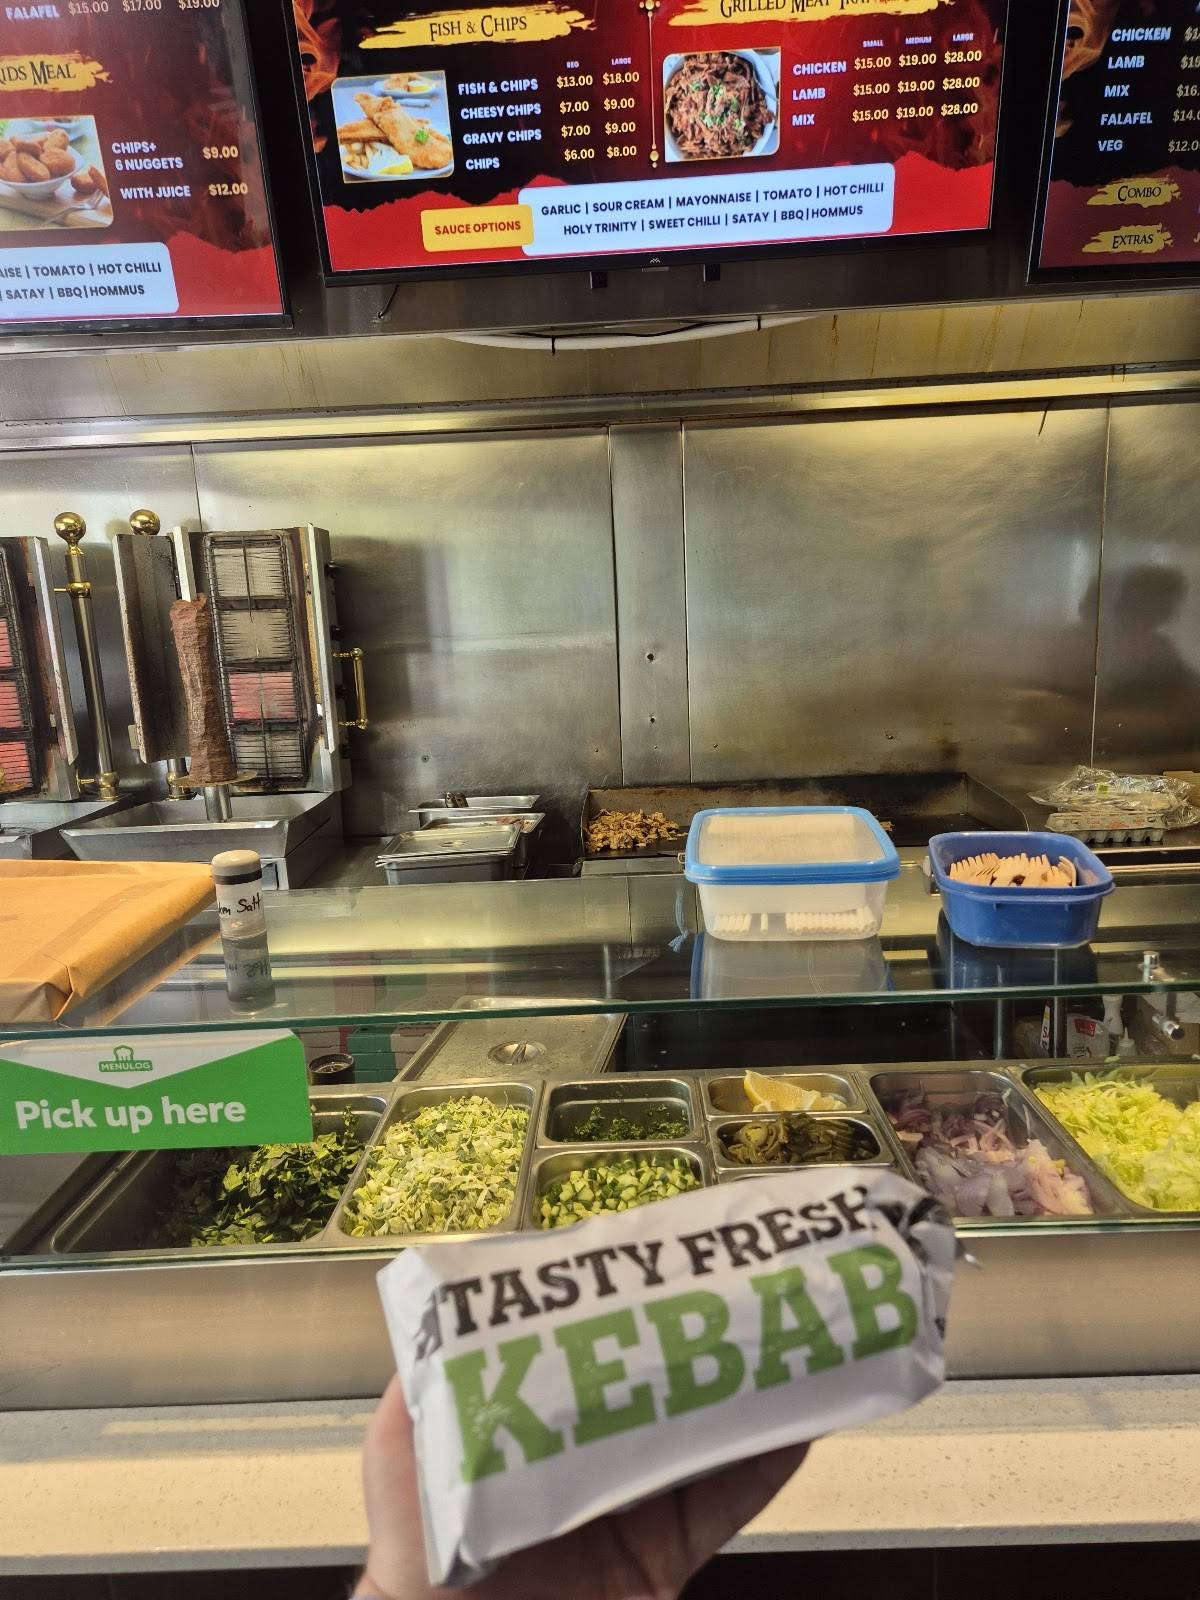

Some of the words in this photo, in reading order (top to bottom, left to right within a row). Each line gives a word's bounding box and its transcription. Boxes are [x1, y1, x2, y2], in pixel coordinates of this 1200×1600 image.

[5, 5, 60, 20] FALAFEL
[68, 1, 109, 16] $15.00
[122, 0, 162, 12] $17.00
[178, 0, 220, 9] $19.00
[720, 0, 786, 18] GRILLED
[429, 21, 462, 42] FISH
[466, 24, 476, 34] &
[481, 15, 527, 37] CHIPS
[1111, 26, 1171, 42] CHICKEN
[862, 39, 884, 48] SMALL
[905, 36, 932, 45] MEDIUM
[952, 32, 974, 42] LARGE
[611, 57, 632, 66] LARGE
[792, 60, 847, 76] CHICKEN
[853, 56, 892, 71] $15.00
[898, 53, 937, 68] $19.00
[944, 50, 982, 65] $28.00
[1107, 54, 1145, 70] LAMB
[29, 60, 77, 86] MEAL
[458, 82, 486, 96] FISH
[488, 81, 498, 94] &
[500, 78, 538, 93] CHIPS
[556, 74, 594, 89] $13.00
[602, 71, 640, 86] $18.00
[792, 87, 826, 101] LAMB
[853, 82, 890, 97] $15.00
[897, 79, 935, 94] $19.00
[942, 76, 980, 91] $28.00
[1104, 84, 1130, 98] MIX
[460, 105, 505, 120] CHEESY
[506, 102, 541, 117] CHIPS
[559, 100, 590, 115] $7.00
[603, 97, 635, 112] $9.00
[792, 113, 815, 126] MIX
[852, 108, 889, 123] $15.00
[895, 105, 934, 120] $19.00
[940, 102, 979, 117] $28.00
[1100, 111, 1153, 126] FALAFEL
[462, 131, 504, 145] GRAVY
[507, 128, 542, 142] CHIPS
[561, 124, 591, 139] $7.00
[604, 121, 636, 136] $9.00
[111, 141, 157, 155] CHIPS+
[202, 146, 239, 160] $9.00
[1097, 139, 1123, 152] VEG
[115, 157, 124, 171] 6
[125, 156, 184, 171] NUGGETS
[465, 157, 500, 171] CHIPS
[564, 148, 595, 162] $6.00
[606, 145, 637, 159] $8.00
[120, 186, 154, 200] WITH
[155, 185, 192, 199] JUICE
[208, 183, 248, 197] $12.00
[541, 203, 582, 216] GARLIC
[592, 200, 625, 213] SOUR
[624, 197, 665, 211] CREAM
[675, 191, 752, 208] MAYONNAISE
[762, 187, 813, 201] TOMATO
[823, 184, 848, 197] HOT
[849, 181, 884, 195] CHILLI
[1117, 185, 1162, 202] COMBO
[434, 224, 471, 236] SAUCE
[473, 220, 522, 233] OPTIONS
[563, 223, 592, 236] HOLY
[594, 220, 637, 234] TRINITY
[648, 217, 685, 231] SWEET
[687, 213, 721, 228] CHILLI
[731, 210, 770, 225] SATAY
[780, 208, 804, 221] BBQ
[811, 204, 864, 219] HOMMUS
[1112, 233, 1154, 250] EXTRAS
[33, 263, 86, 278] TOMATO
[97, 261, 123, 275] HOT
[124, 260, 162, 274] CHILLI
[6, 286, 46, 300] SATAY
[57, 284, 83, 298] BBQ
[90, 283, 145, 297] HOMMUS
[100, 1060, 151, 1072] MENULOG
[15, 1097, 97, 1130] Pick
[104, 1105, 154, 1133] up
[162, 1094, 246, 1125] here
[438, 1239, 668, 1338] TASTY
[444, 1243, 919, 1483] KEBAB
